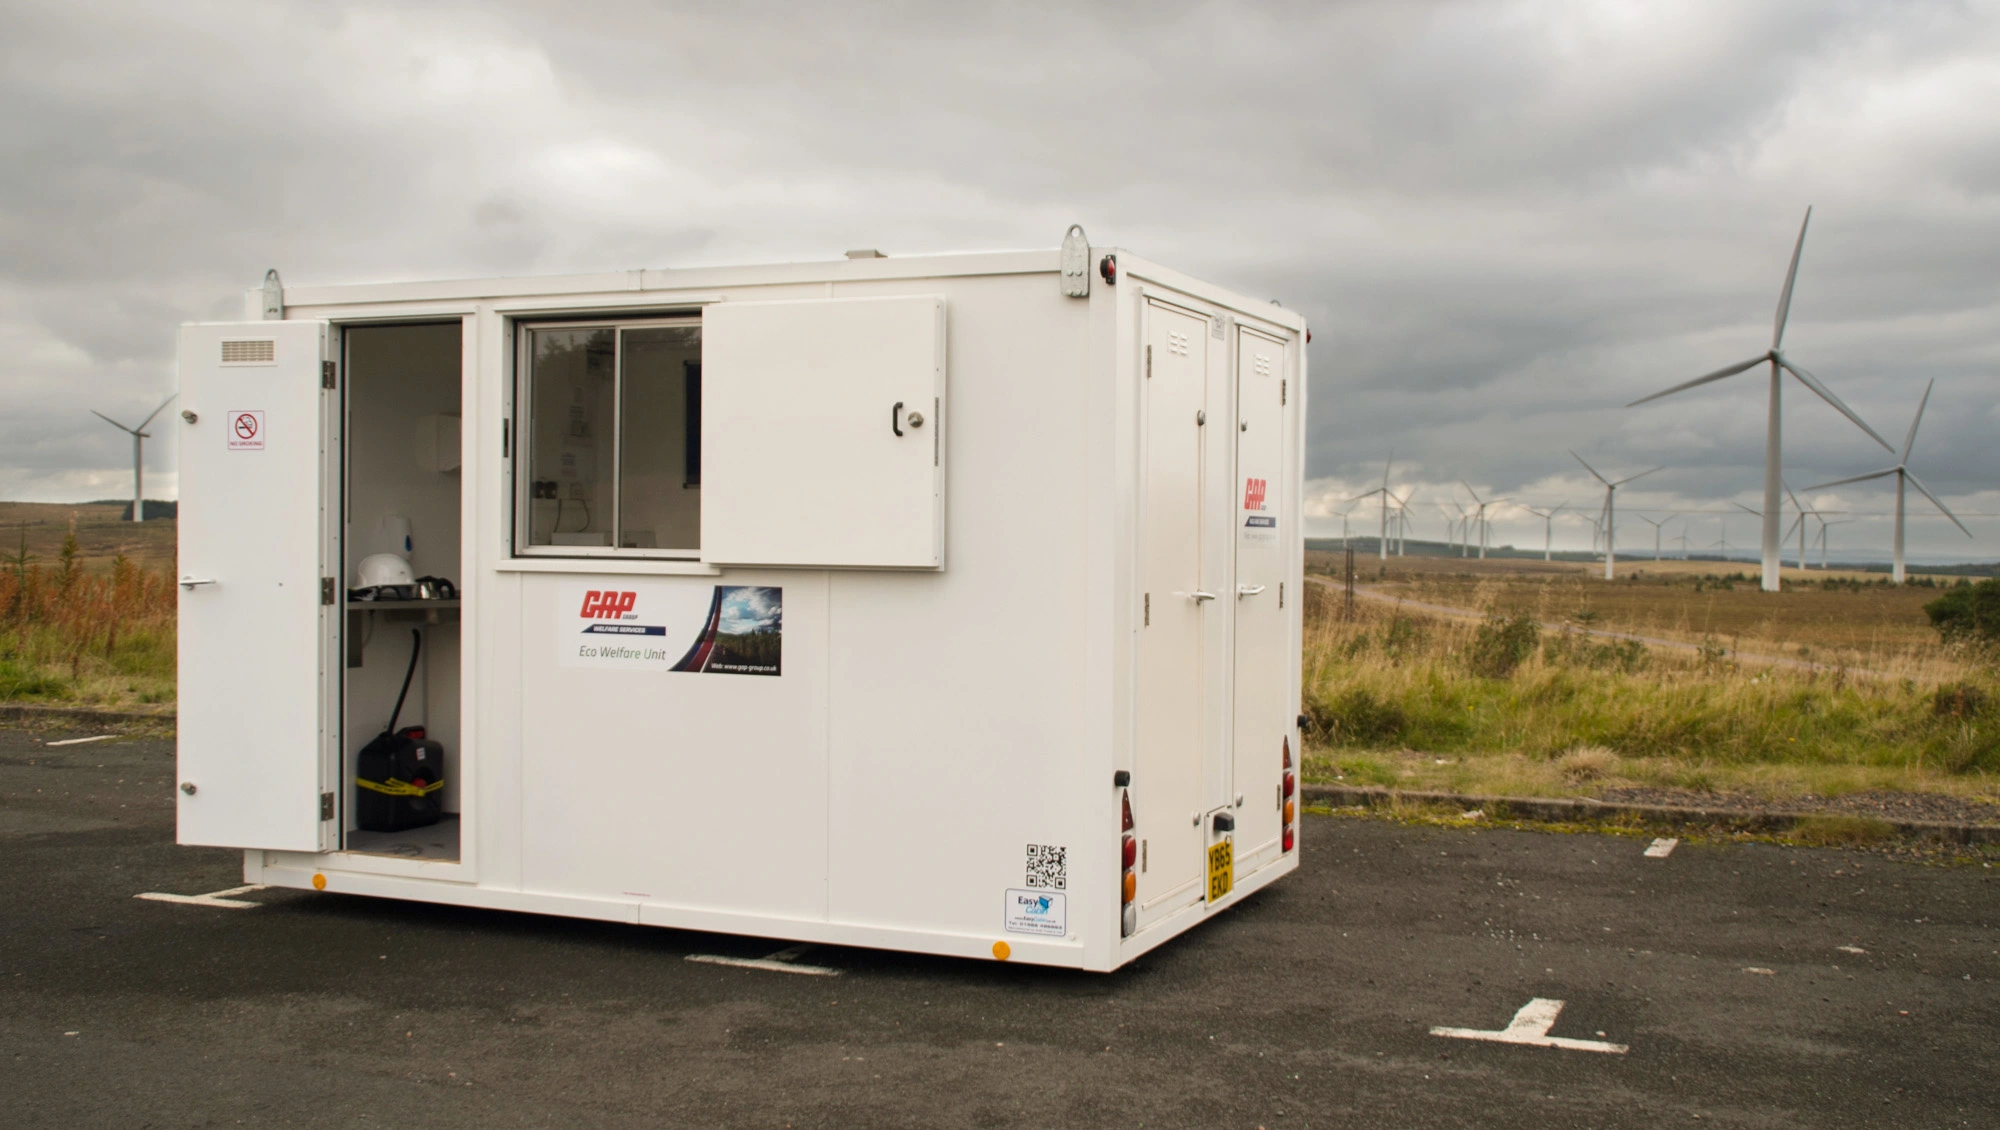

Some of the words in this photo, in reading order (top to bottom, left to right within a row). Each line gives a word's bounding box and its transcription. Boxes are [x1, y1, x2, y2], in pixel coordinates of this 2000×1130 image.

[1244, 478, 1266, 510] GAP
[580, 590, 637, 619] GAP
[579, 645, 597, 657] Eco
[600, 646, 641, 659] Welfare
[644, 648, 666, 660] Unit
[724, 664, 777, 672] www.gap-group.co.uk
[1209, 843, 1230, 873] YB65
[1018, 896, 1038, 907] Easy
